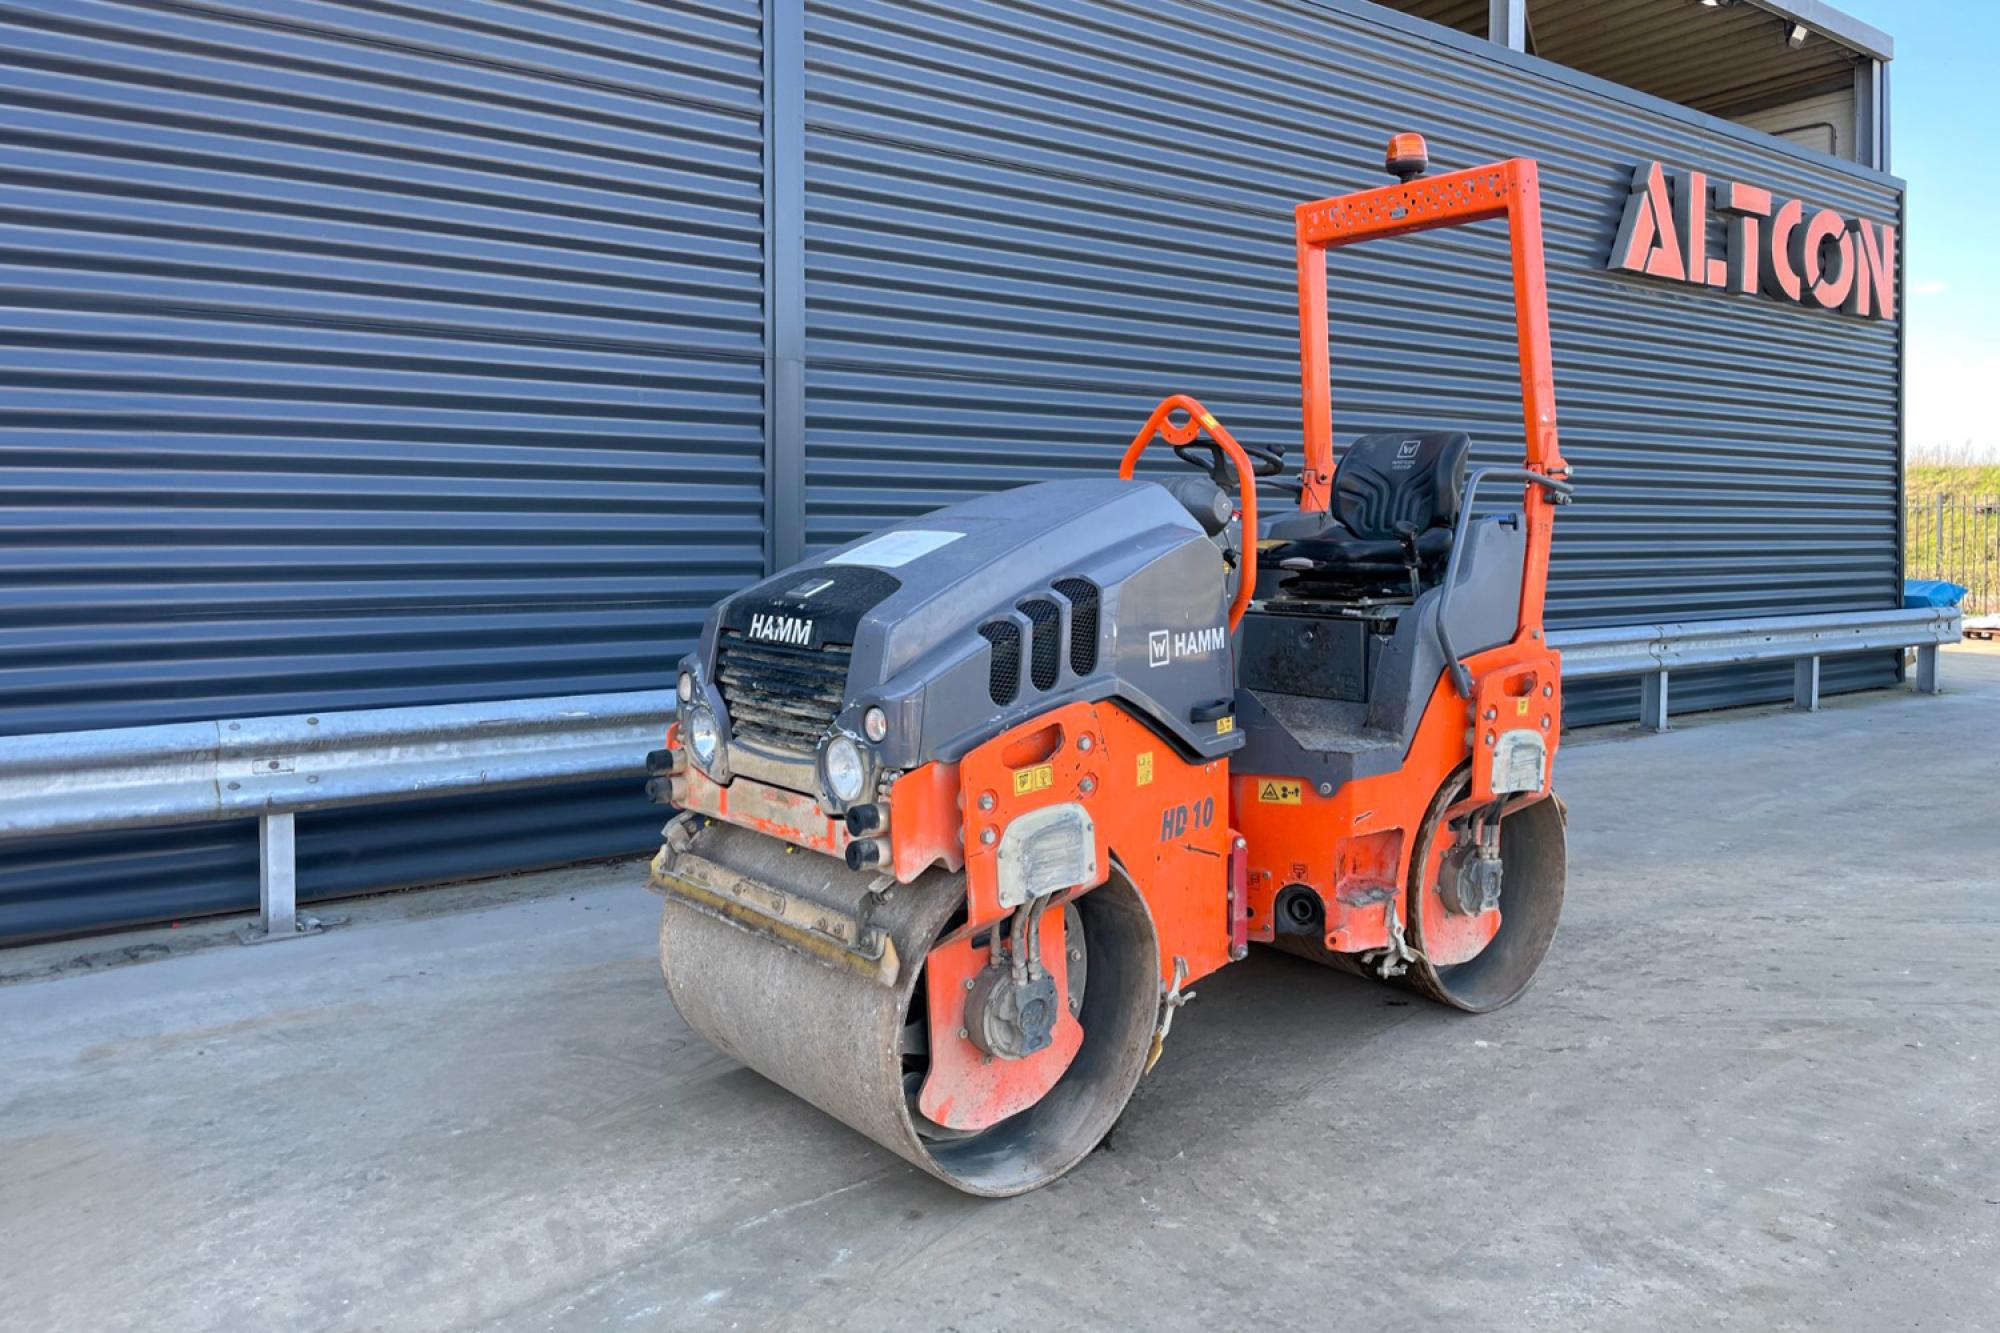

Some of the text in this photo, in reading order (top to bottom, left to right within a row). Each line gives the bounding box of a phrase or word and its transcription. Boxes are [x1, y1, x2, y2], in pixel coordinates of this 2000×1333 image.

[1612, 160, 1895, 321] ALTCON
[748, 612, 813, 646] HAMM
[1174, 626, 1225, 657] HAMM
[1161, 796, 1214, 842] HD 10
